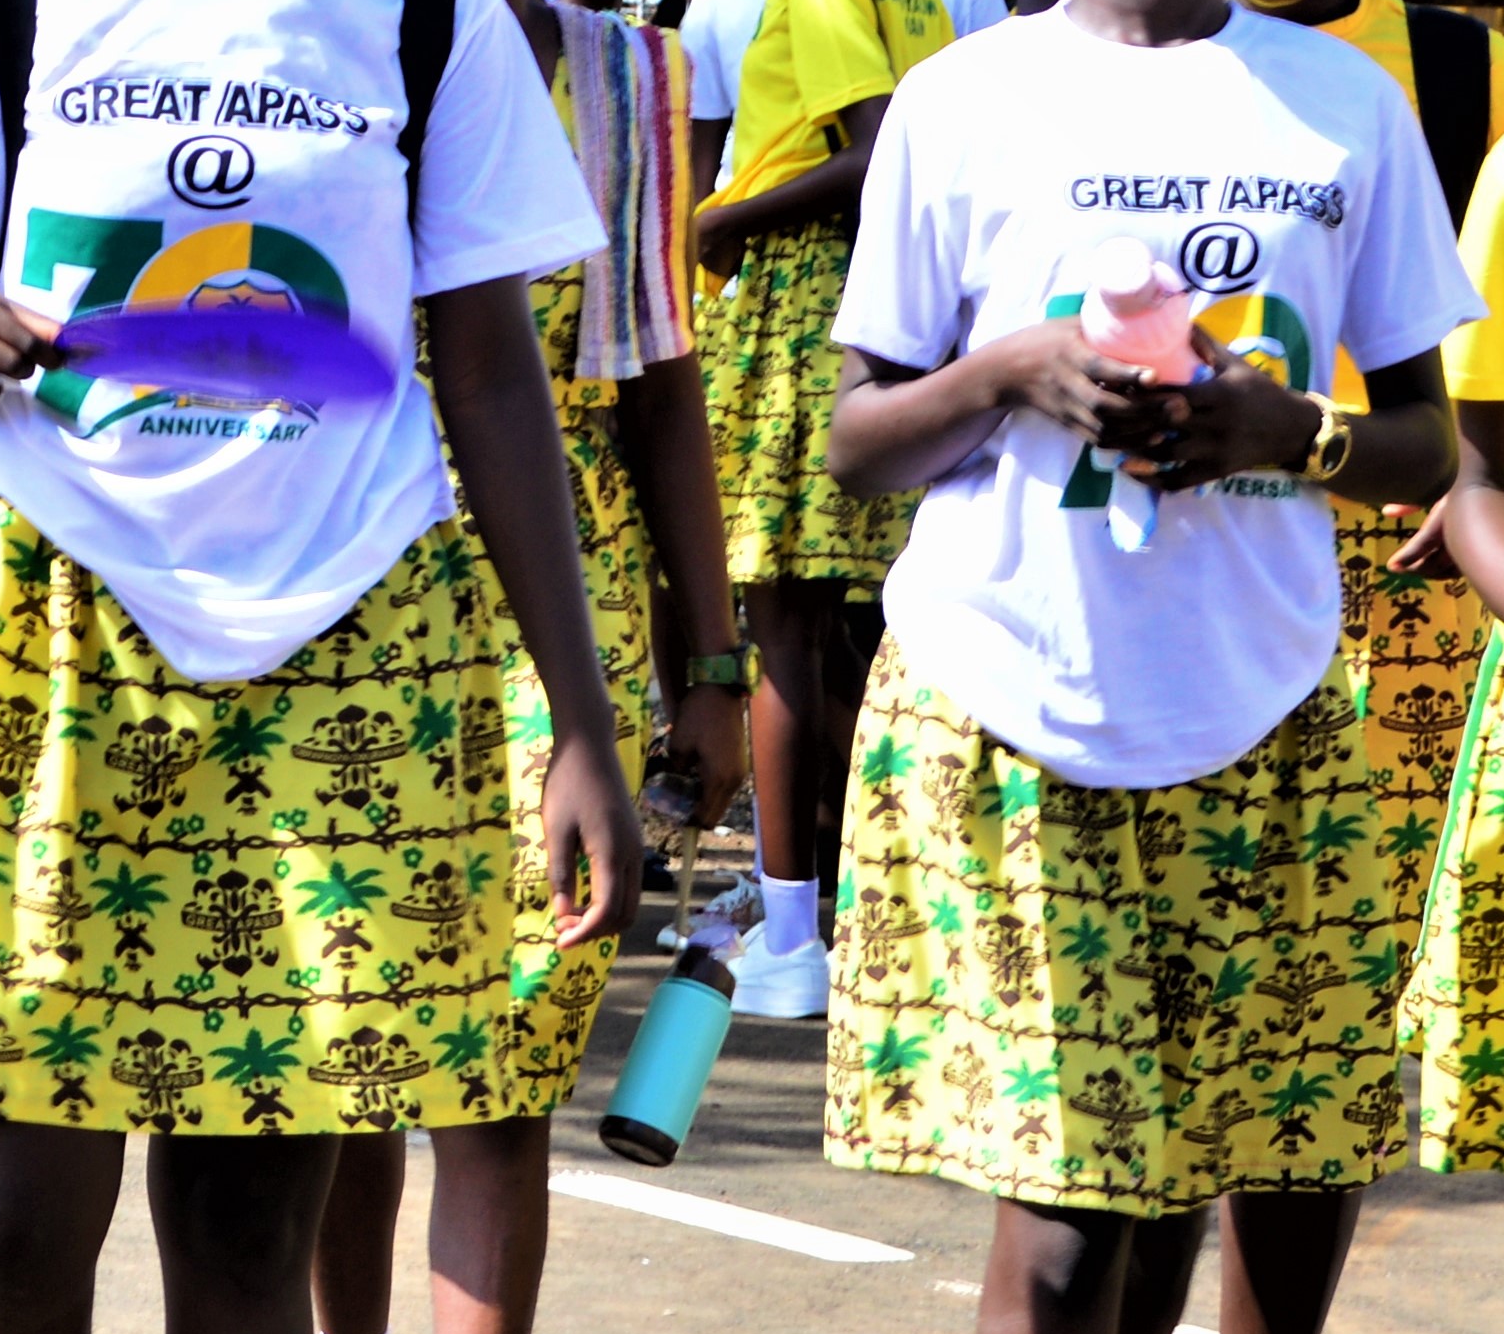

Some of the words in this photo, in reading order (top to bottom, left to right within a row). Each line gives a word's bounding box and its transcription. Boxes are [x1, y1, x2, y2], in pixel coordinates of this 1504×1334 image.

[55, 78, 212, 125] GREAT
[214, 80, 370, 136] APASS
[167, 135, 256, 210] @
[1064, 174, 1211, 212] GREAT
[1218, 175, 1346, 229] APASS
[1179, 222, 1259, 295] @
[138, 415, 310, 443] ANNIVERSARY
